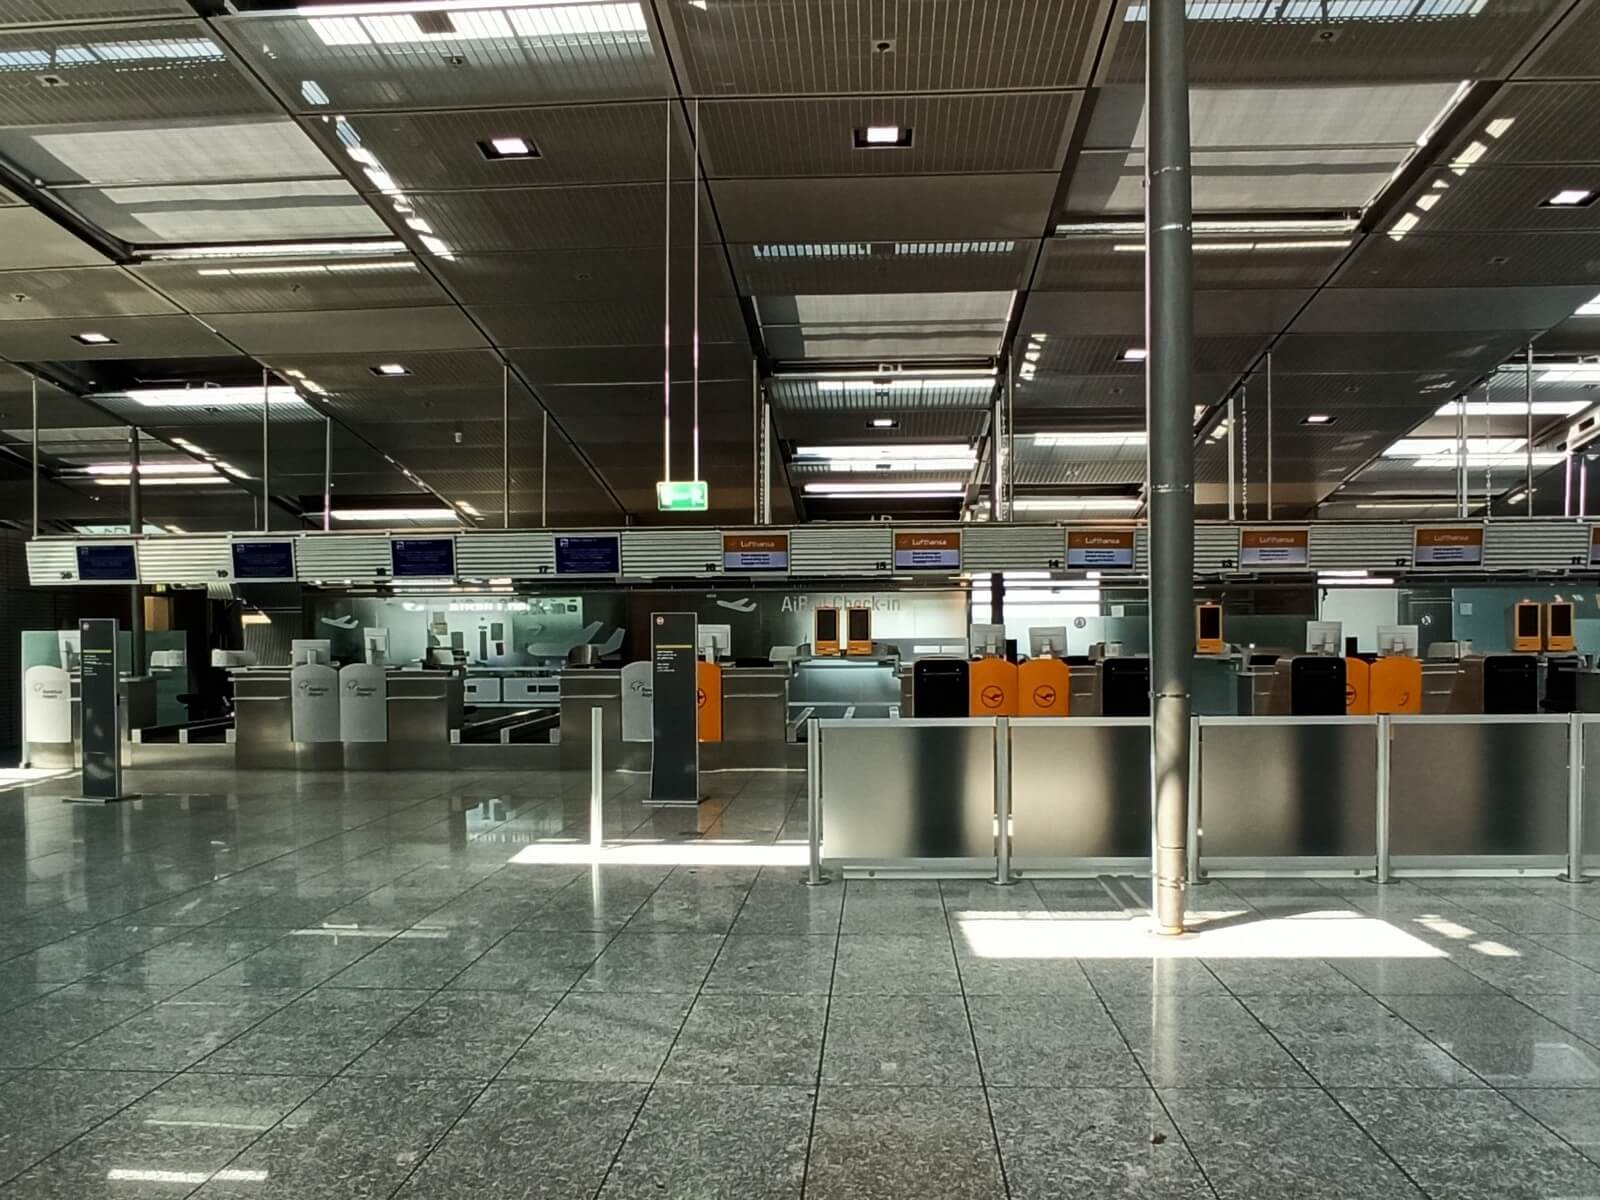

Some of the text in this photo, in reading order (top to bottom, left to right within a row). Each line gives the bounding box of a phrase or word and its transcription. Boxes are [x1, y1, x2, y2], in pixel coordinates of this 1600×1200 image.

[740, 540, 775, 548] Lufthansa
[912, 538, 947, 546] Lufthansa
[1085, 537, 1120, 545] Lufthansa
